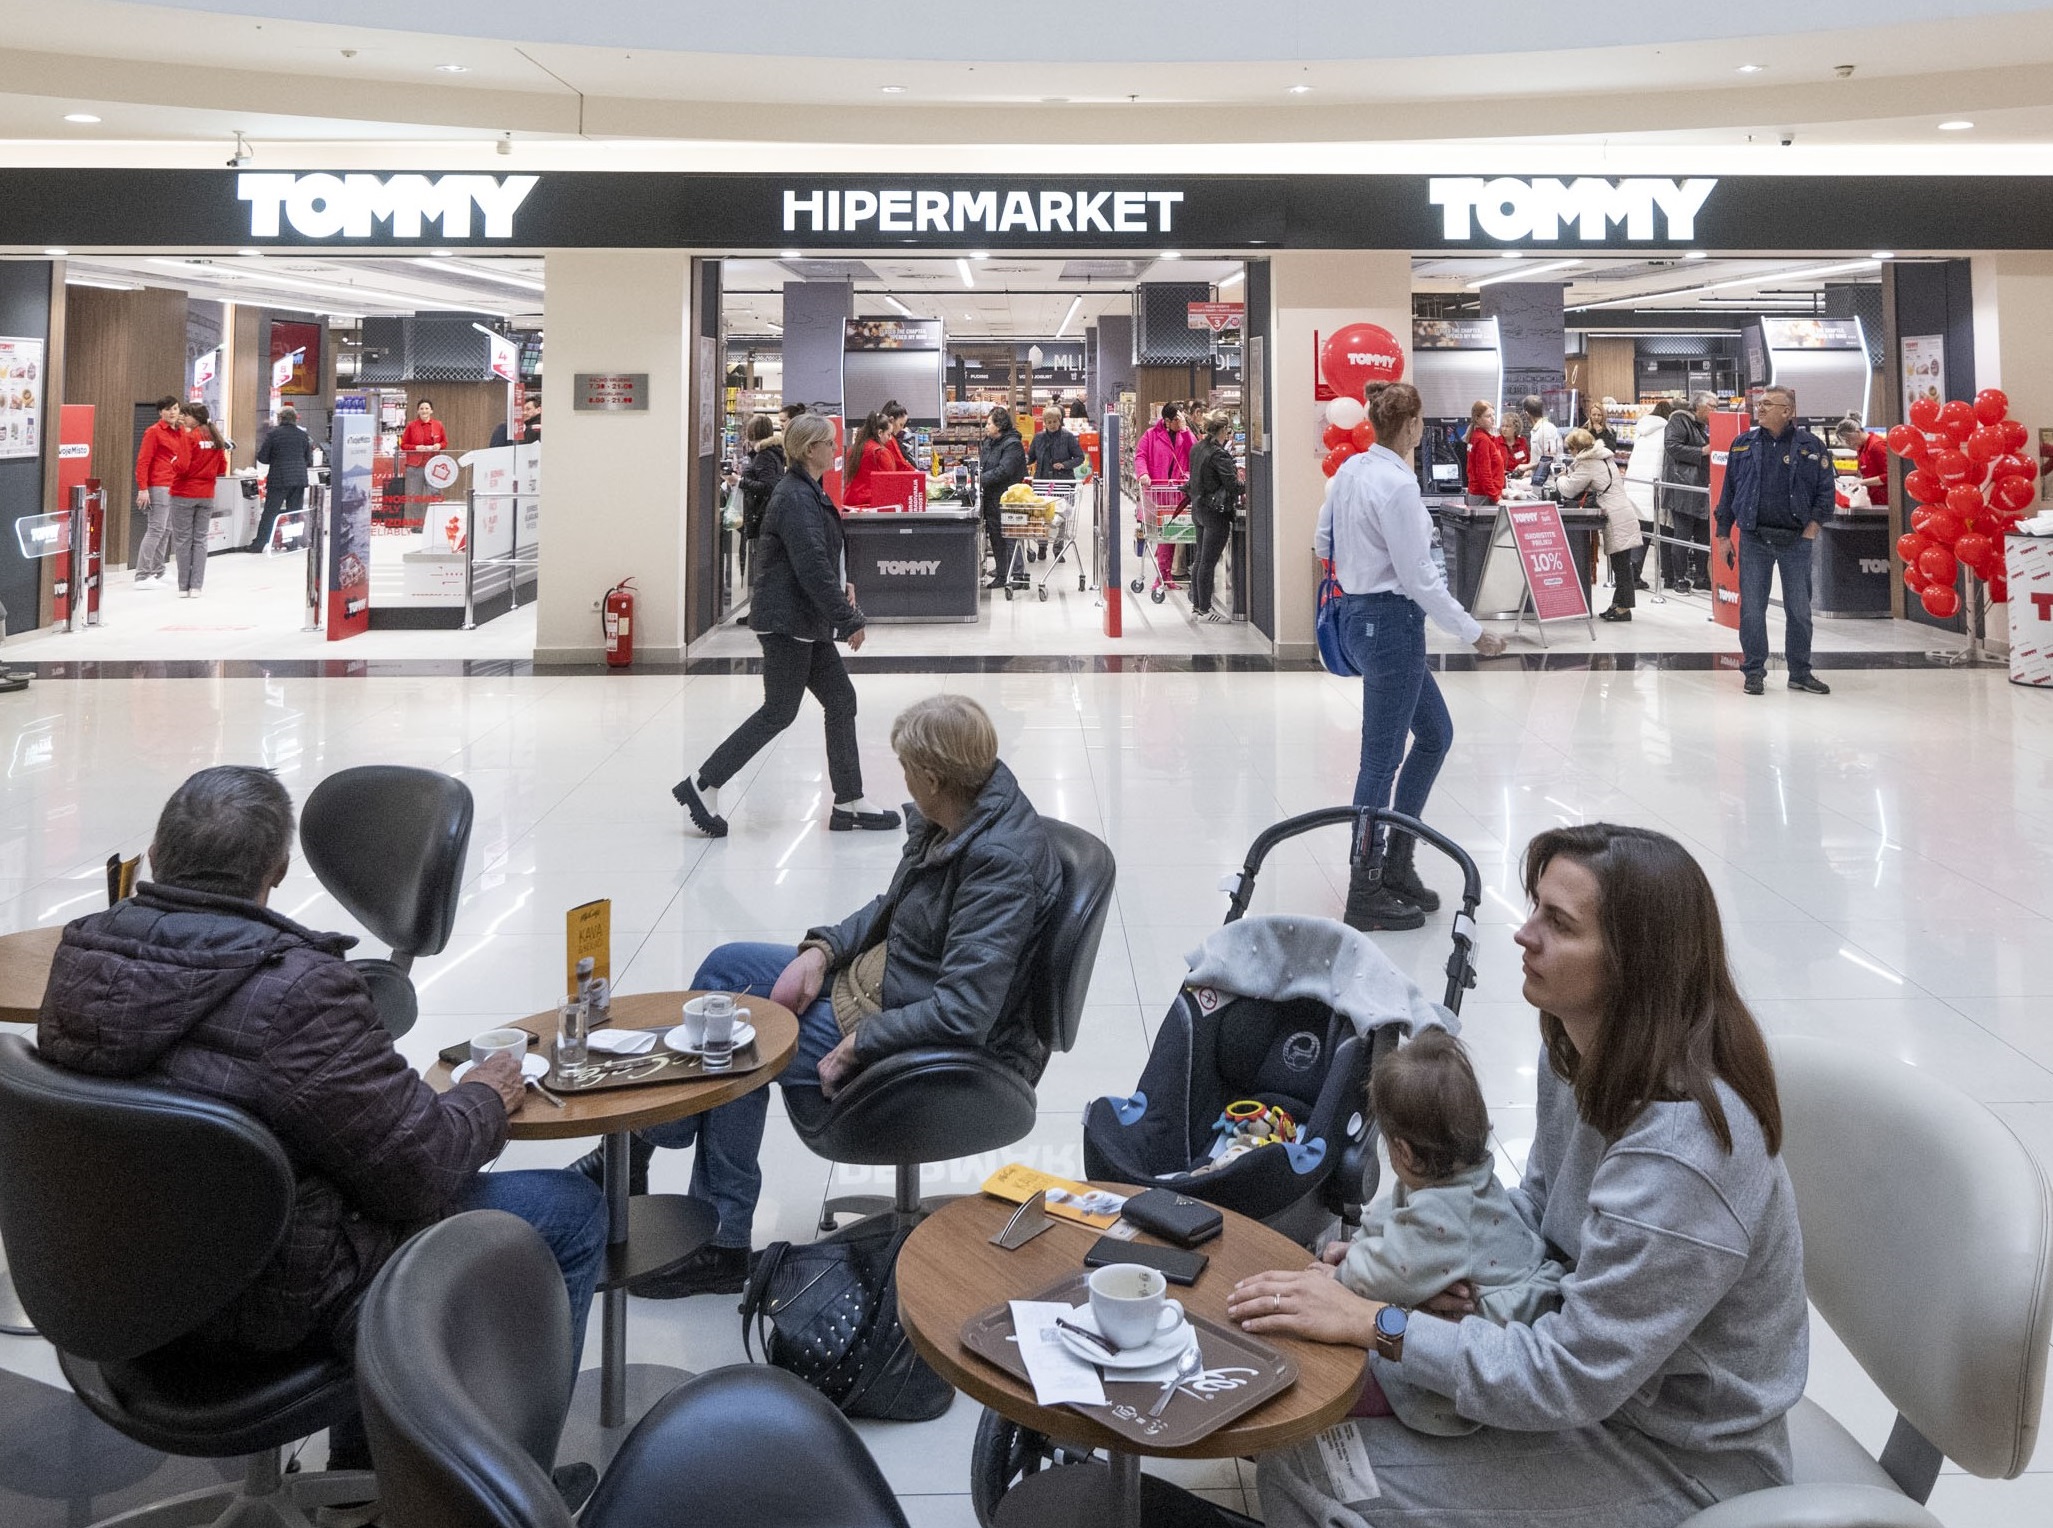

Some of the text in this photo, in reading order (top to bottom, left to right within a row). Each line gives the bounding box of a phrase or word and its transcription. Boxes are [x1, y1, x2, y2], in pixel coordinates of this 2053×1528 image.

[237, 173, 541, 238] TOMMY
[783, 190, 1184, 232] HIPERMARKET
[1429, 177, 1719, 240] TOMMY
[1214, 320, 1221, 328] 3
[498, 351, 508, 361] 4
[1054, 354, 1085, 371] MLI
[1347, 353, 1396, 369] TOMMY
[59, 446, 88, 456] vojeMisto
[371, 495, 445, 504] EDNOSTAVNO
[371, 519, 424, 527] OUZDANO
[371, 528, 412, 536] ELIABLY
[877, 560, 941, 575] TOMMY
[578, 923, 603, 943] KAVA
